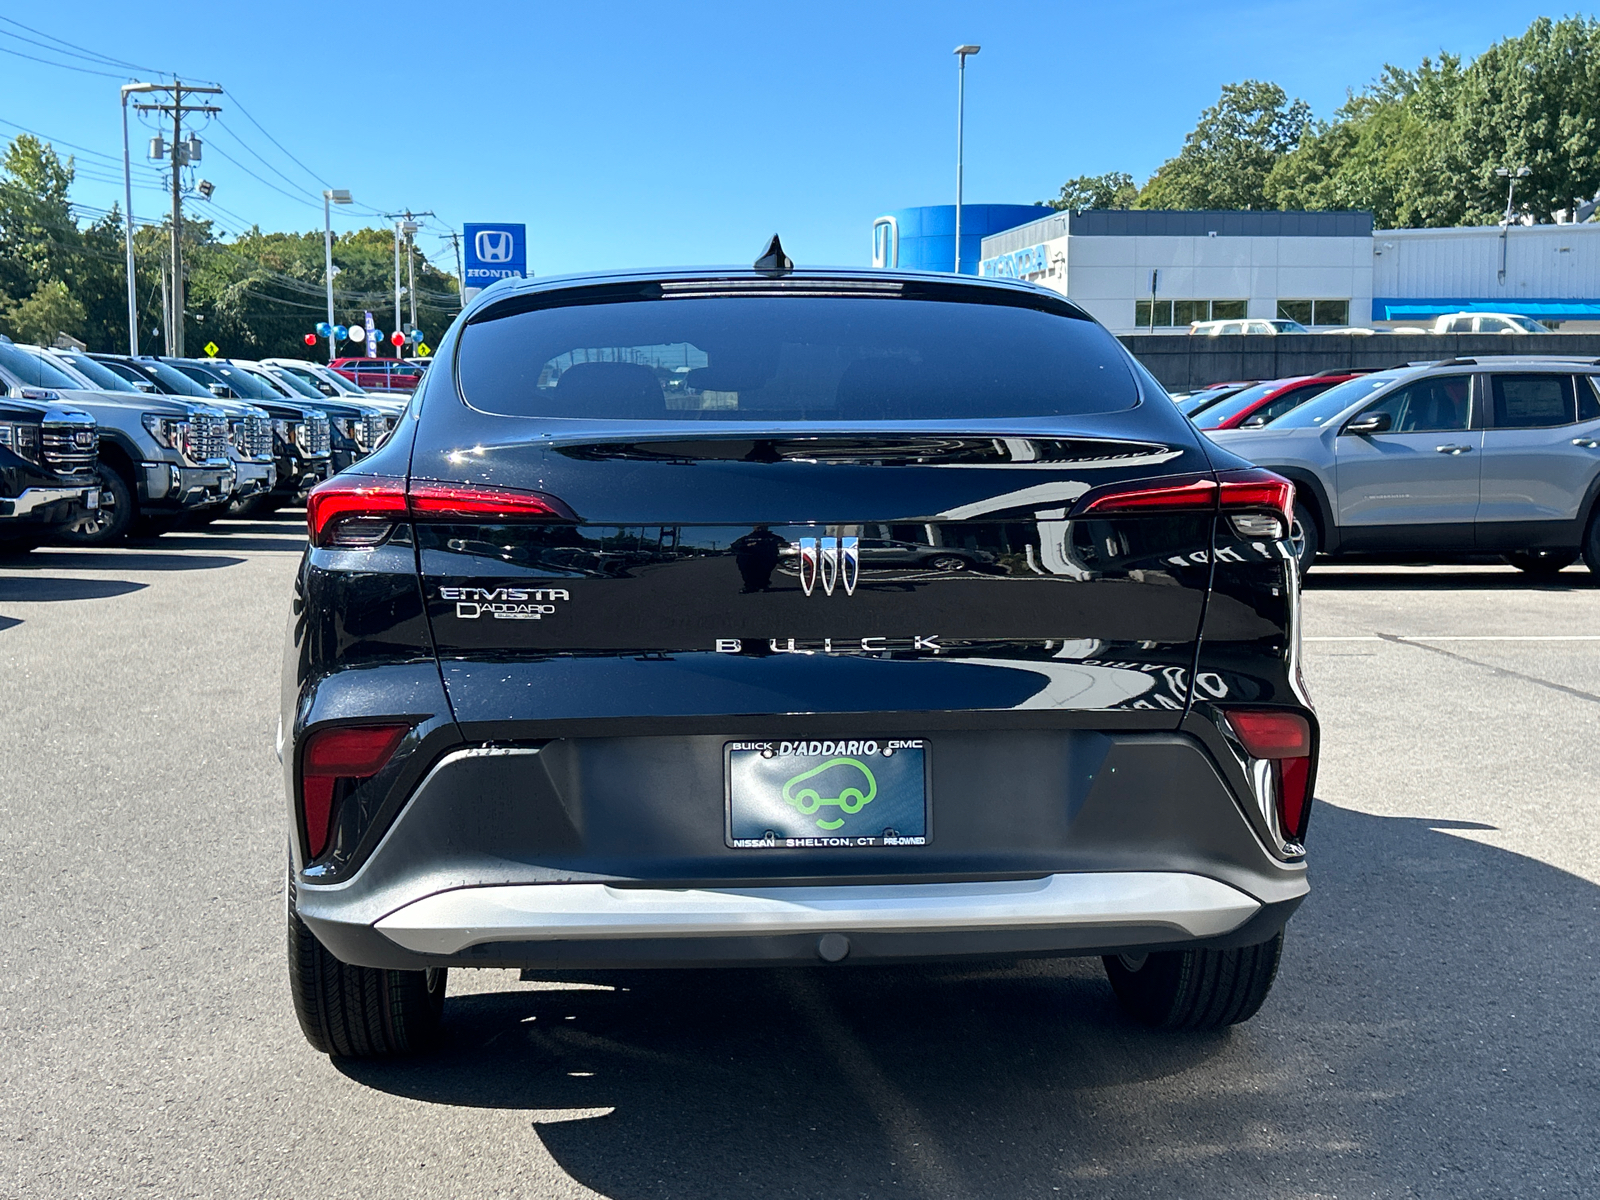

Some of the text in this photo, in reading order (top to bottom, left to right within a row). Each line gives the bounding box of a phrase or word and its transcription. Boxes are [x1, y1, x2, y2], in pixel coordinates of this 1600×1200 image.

[467, 268, 522, 278] HONDA
[440, 587, 570, 601] ENVISTA
[456, 602, 556, 619] D'ADDARIO
[715, 634, 942, 654] BUICK
[732, 740, 923, 756] BUICK D'ADDARIO GMC
[733, 837, 925, 847] NISSAN SHELTON, CT PRE-OWNED
